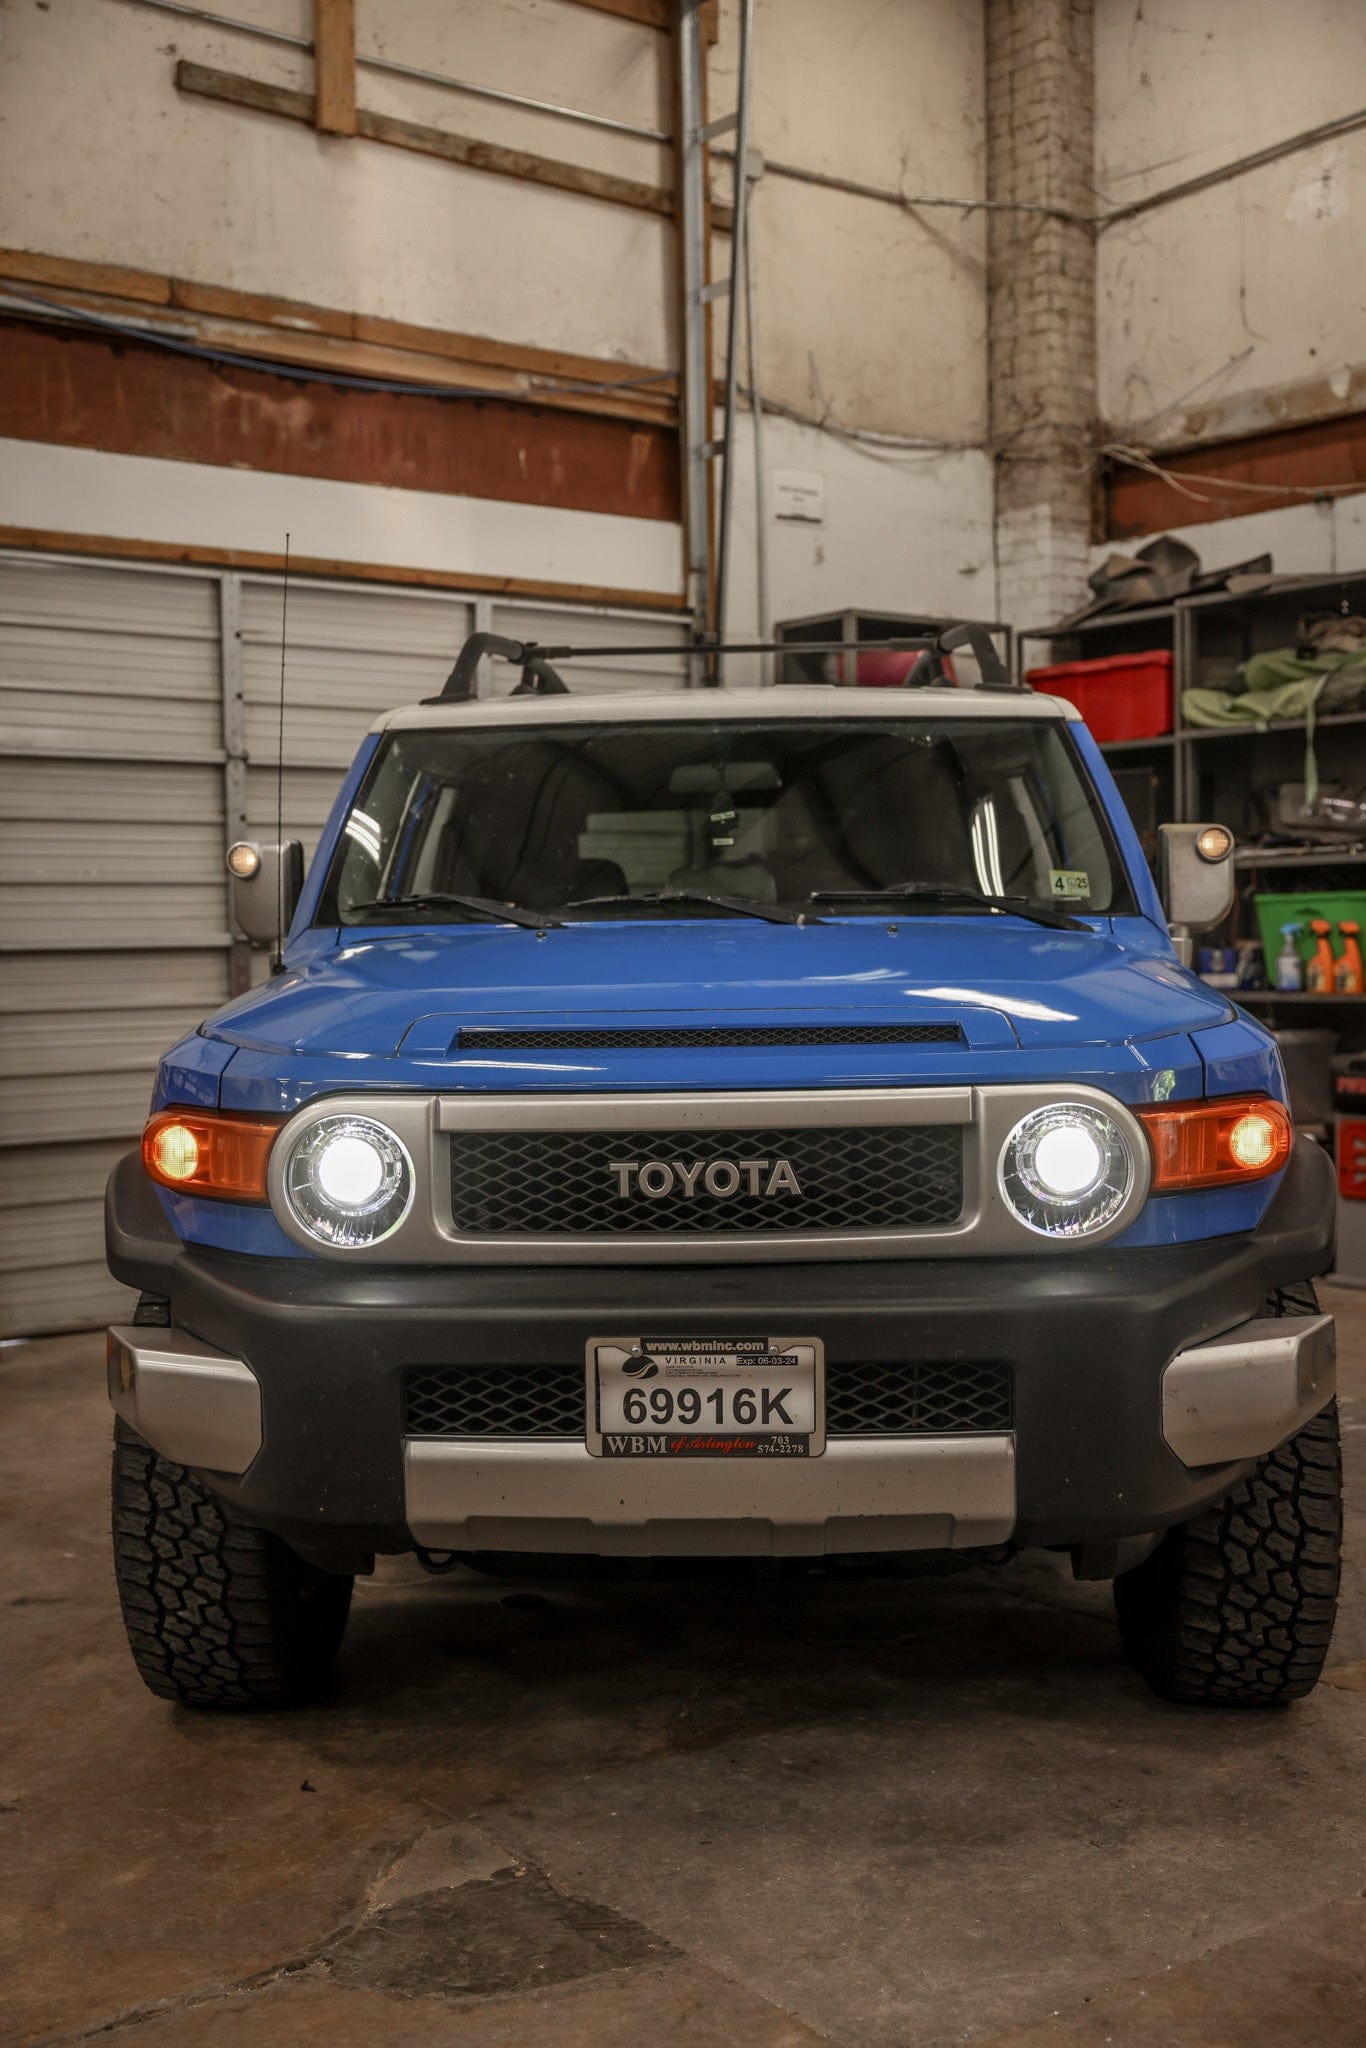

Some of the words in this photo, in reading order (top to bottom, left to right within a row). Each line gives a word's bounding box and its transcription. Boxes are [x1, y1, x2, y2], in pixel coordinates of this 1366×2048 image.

[1055, 876, 1065, 891] 4
[1076, 877, 1088, 889] 25
[609, 1160, 802, 1198] TOYOTA
[737, 1357, 755, 1366] Exp:
[758, 1357, 796, 1365] 06-03-24
[622, 1388, 794, 1425] 69916K
[606, 1435, 668, 1454] WBM
[670, 1436, 685, 1454] of
[683, 1436, 756, 1455] Arlington
[771, 1436, 789, 1444] 703
[757, 1444, 804, 1454] 574-2278
